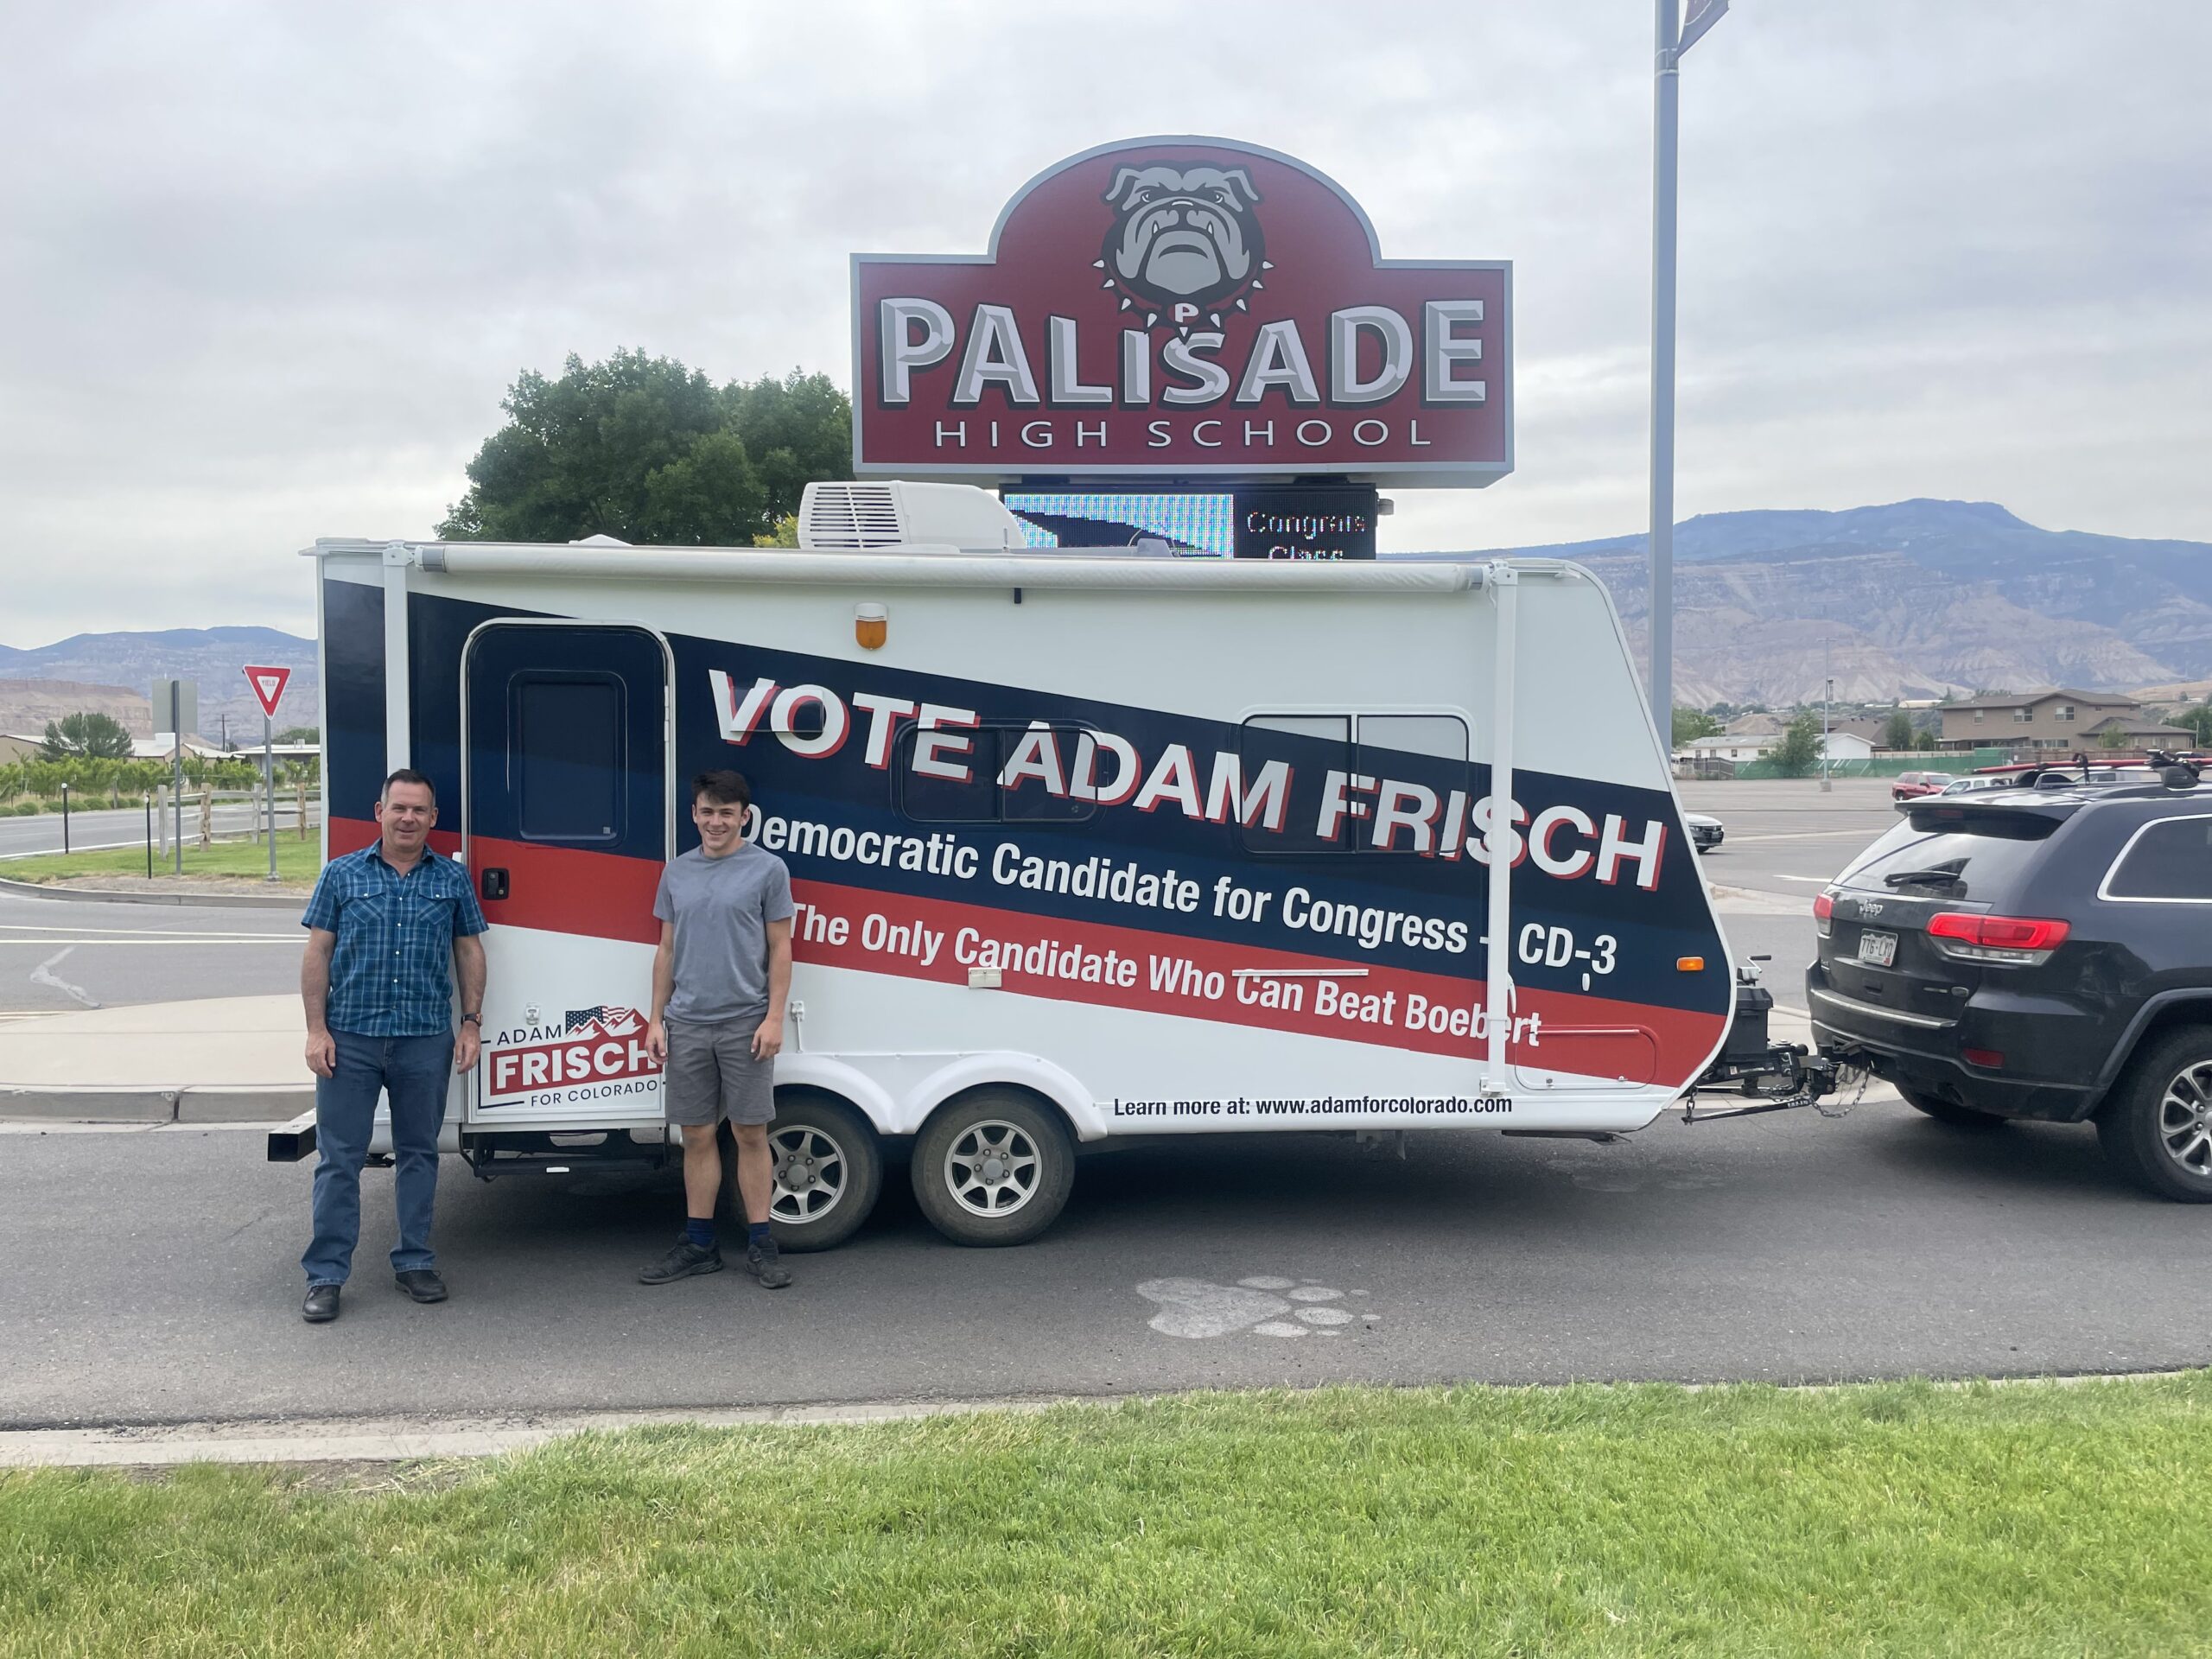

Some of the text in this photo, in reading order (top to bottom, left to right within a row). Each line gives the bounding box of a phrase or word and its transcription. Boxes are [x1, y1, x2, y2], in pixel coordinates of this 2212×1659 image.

[1175, 303, 1198, 322] P
[879, 298, 1487, 406] PALISADE
[935, 419, 1431, 448] HIGH SCHOOL
[1247, 512, 1365, 539] Congrats
[709, 669, 1668, 891] VOTE ADAM FRISCH
[992, 843, 1200, 912] Candidate
[1213, 876, 1271, 923] for
[1282, 887, 1468, 954] Congress
[1518, 923, 1618, 975] CD-3
[1859, 899, 1884, 916] Jeep
[791, 902, 849, 946] The
[861, 913, 944, 966] Only
[955, 927, 1138, 988] Candidate
[1148, 955, 1225, 1000] Who
[1236, 969, 1303, 1012] Can
[1314, 981, 1394, 1026] Beat
[497, 1024, 562, 1046] ADAM
[496, 1039, 658, 1090] FRISCH
[531, 1080, 658, 1107] FOR COLORADO
[1114, 1096, 1513, 1116] Learn more at: www.adamforcolorado.com
